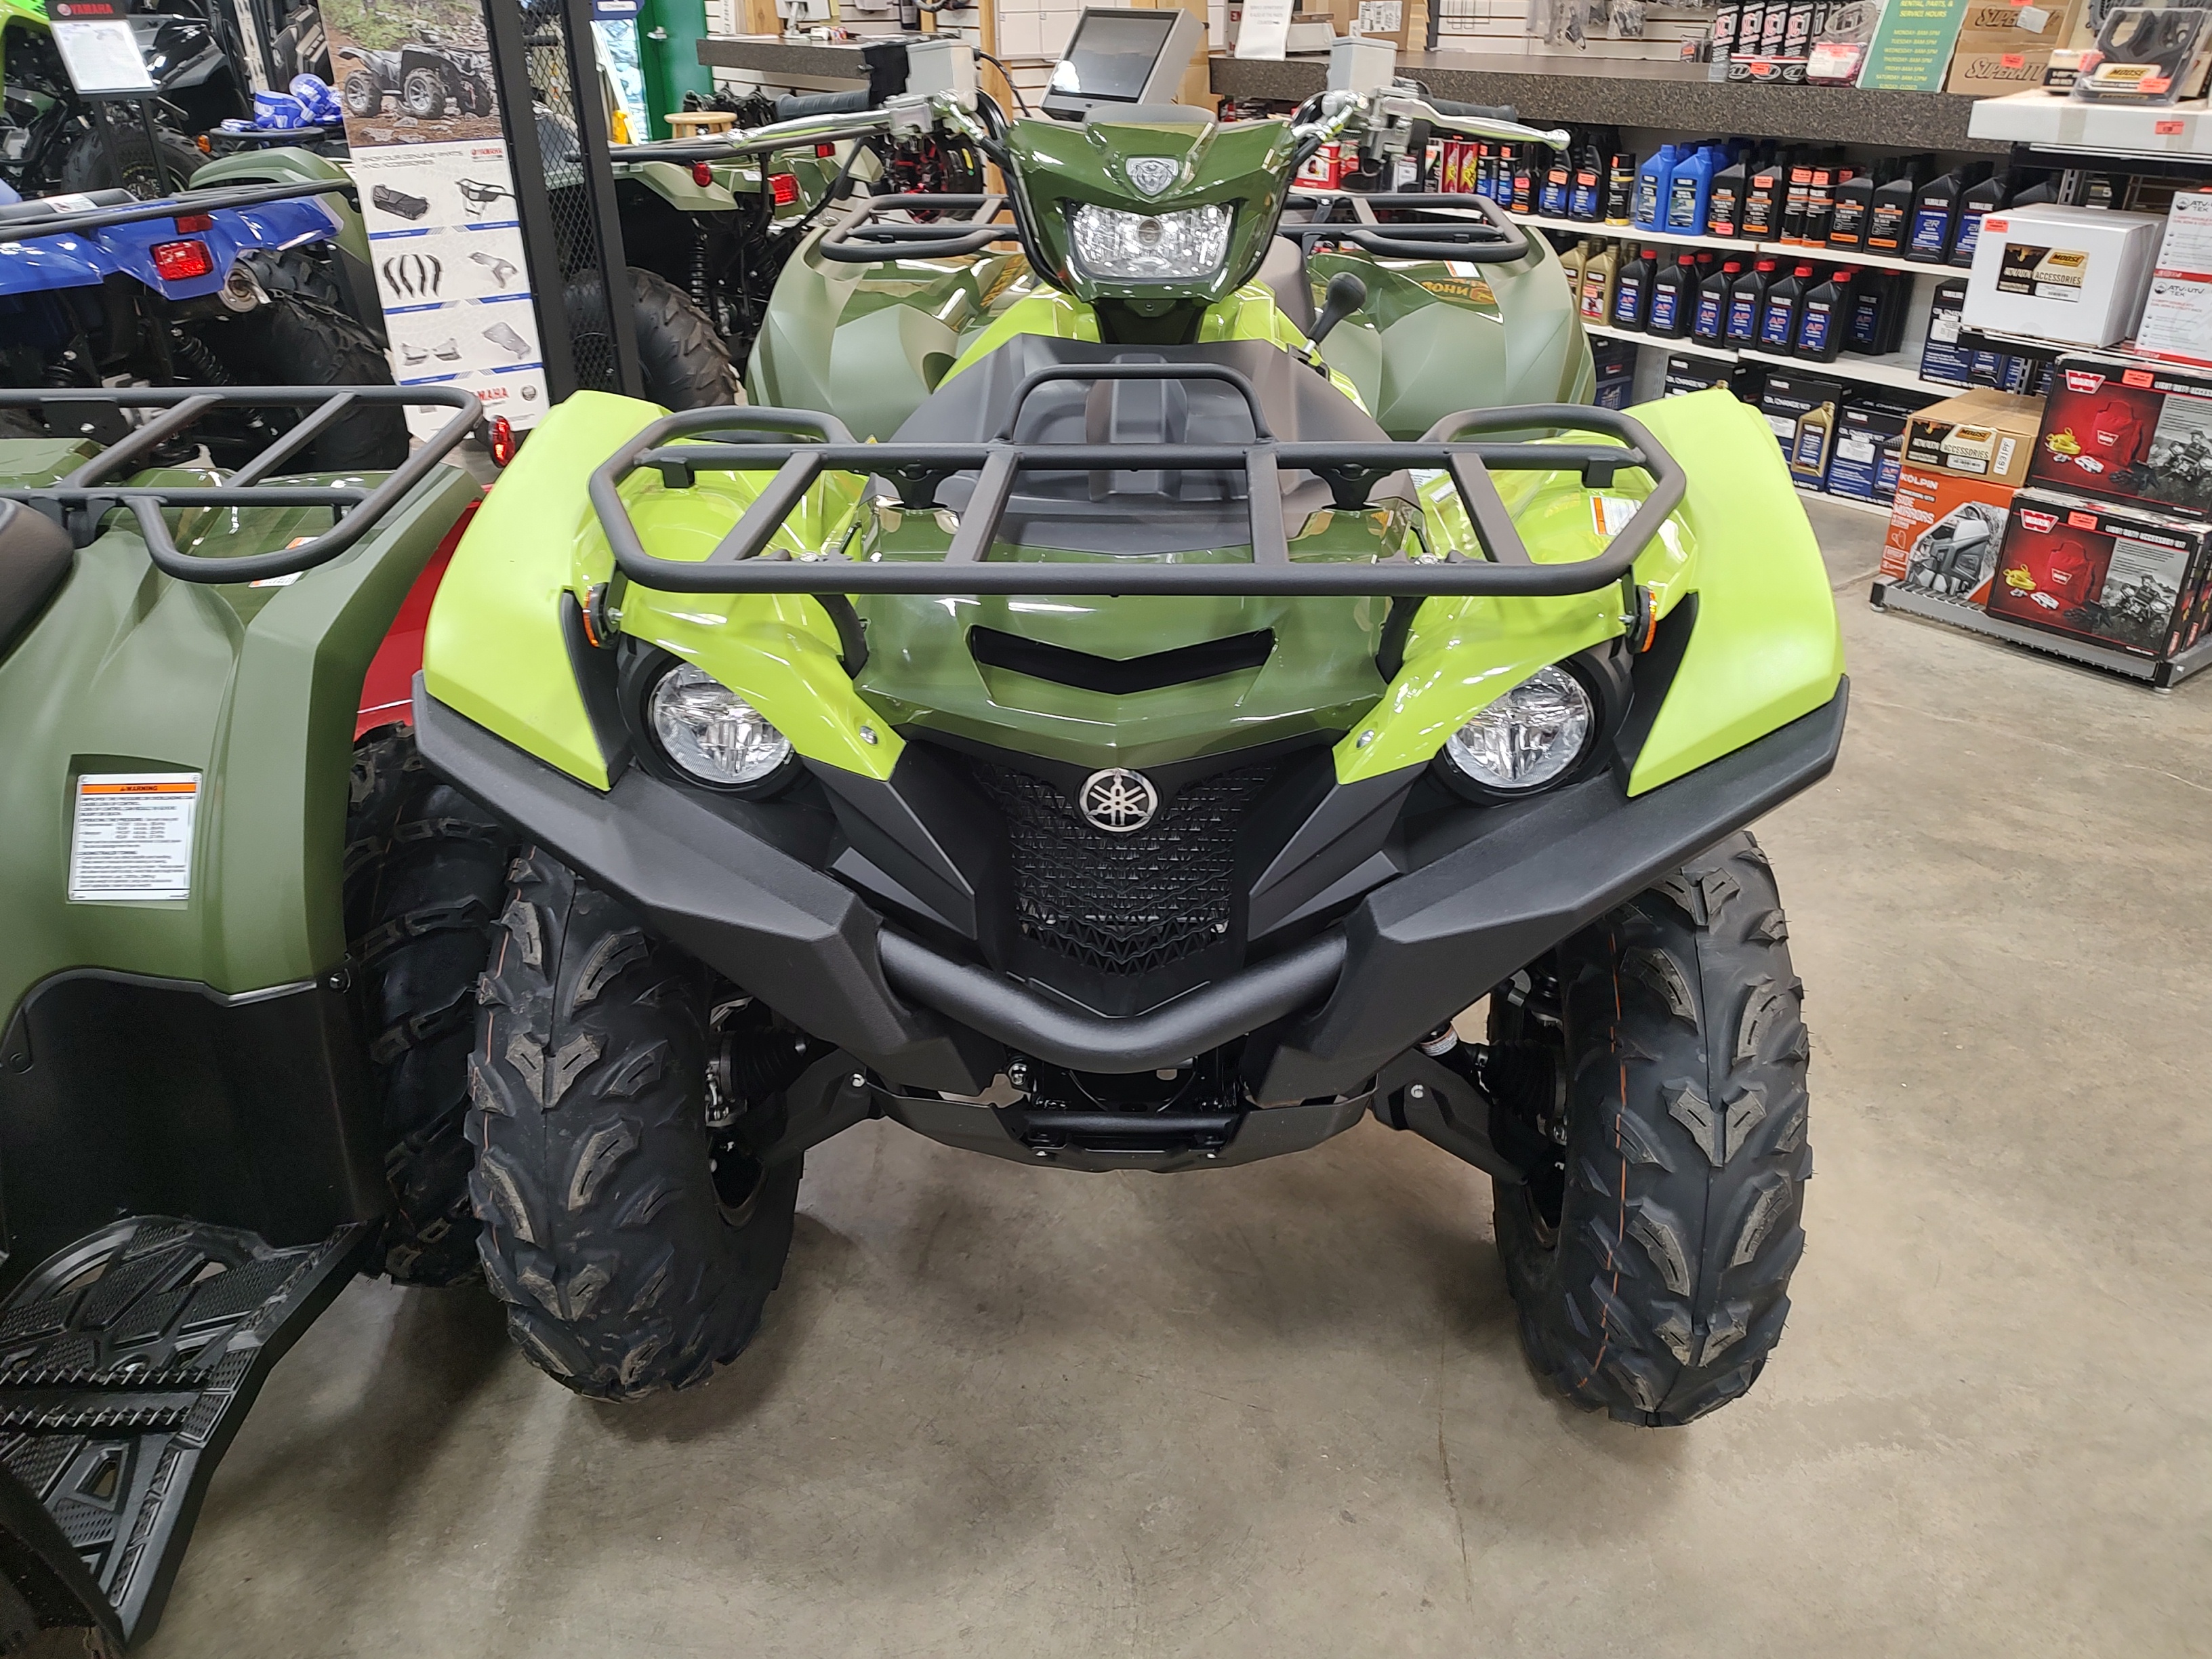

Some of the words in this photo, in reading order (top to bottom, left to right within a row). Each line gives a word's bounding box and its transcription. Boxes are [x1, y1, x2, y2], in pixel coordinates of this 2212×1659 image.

[2110, 68, 2146, 77] MOOSE
[1923, 219, 1940, 228] 2R
[2052, 253, 2083, 263] MOOSE
[2034, 271, 2082, 285] ACCESSORIES
[2168, 285, 2205, 294] ATV-UTV
[1805, 322, 1824, 331] AP
[1961, 428, 1990, 438] MOOSE
[1943, 443, 1990, 459] ACCESSORIES
[1900, 472, 1940, 490] KOLPIN
[1895, 493, 1916, 508] SIDE
[1893, 503, 1936, 525] MIRRORS
